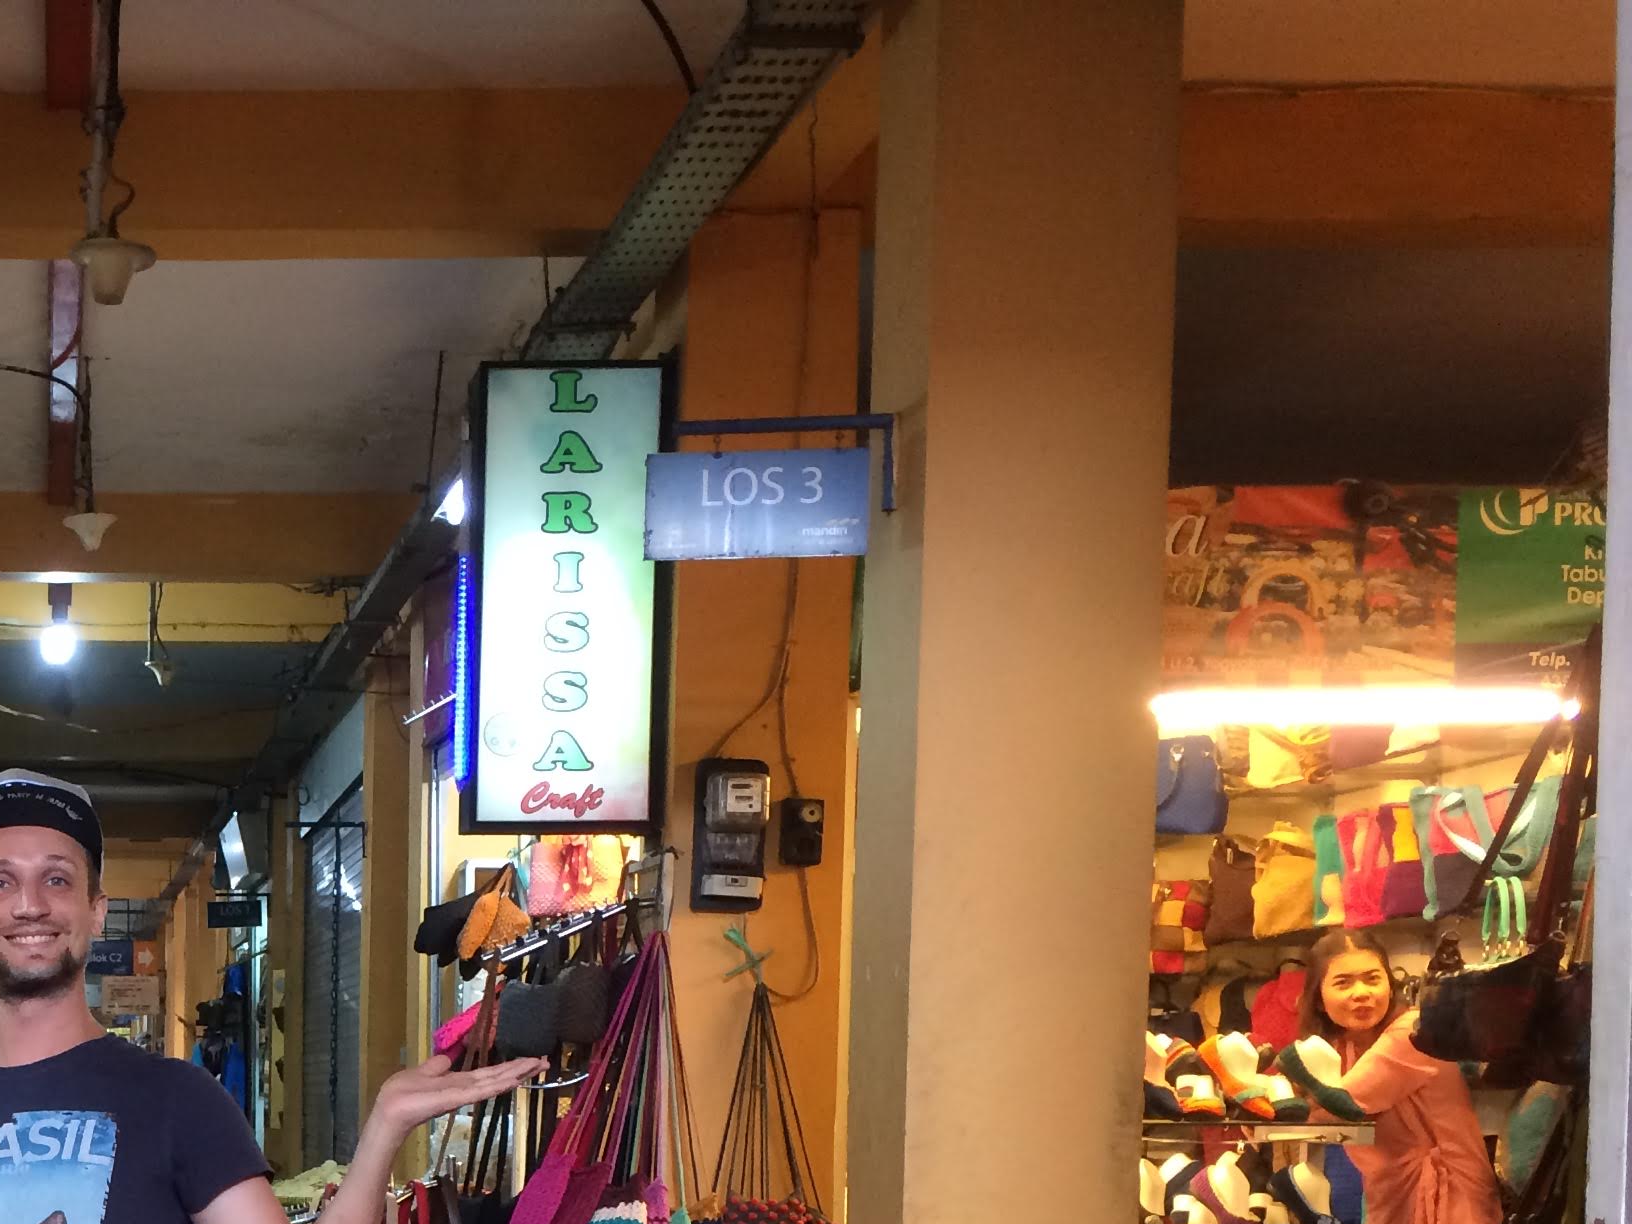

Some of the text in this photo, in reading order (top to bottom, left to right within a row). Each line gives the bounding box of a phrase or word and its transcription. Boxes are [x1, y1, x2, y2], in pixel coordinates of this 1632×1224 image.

[701, 466, 824, 508] LOS 3
[533, 370, 603, 771] LARISSA
[1528, 651, 1571, 670] Telp.
[520, 781, 604, 817] Craft
[90, 952, 122, 963] lok C2
